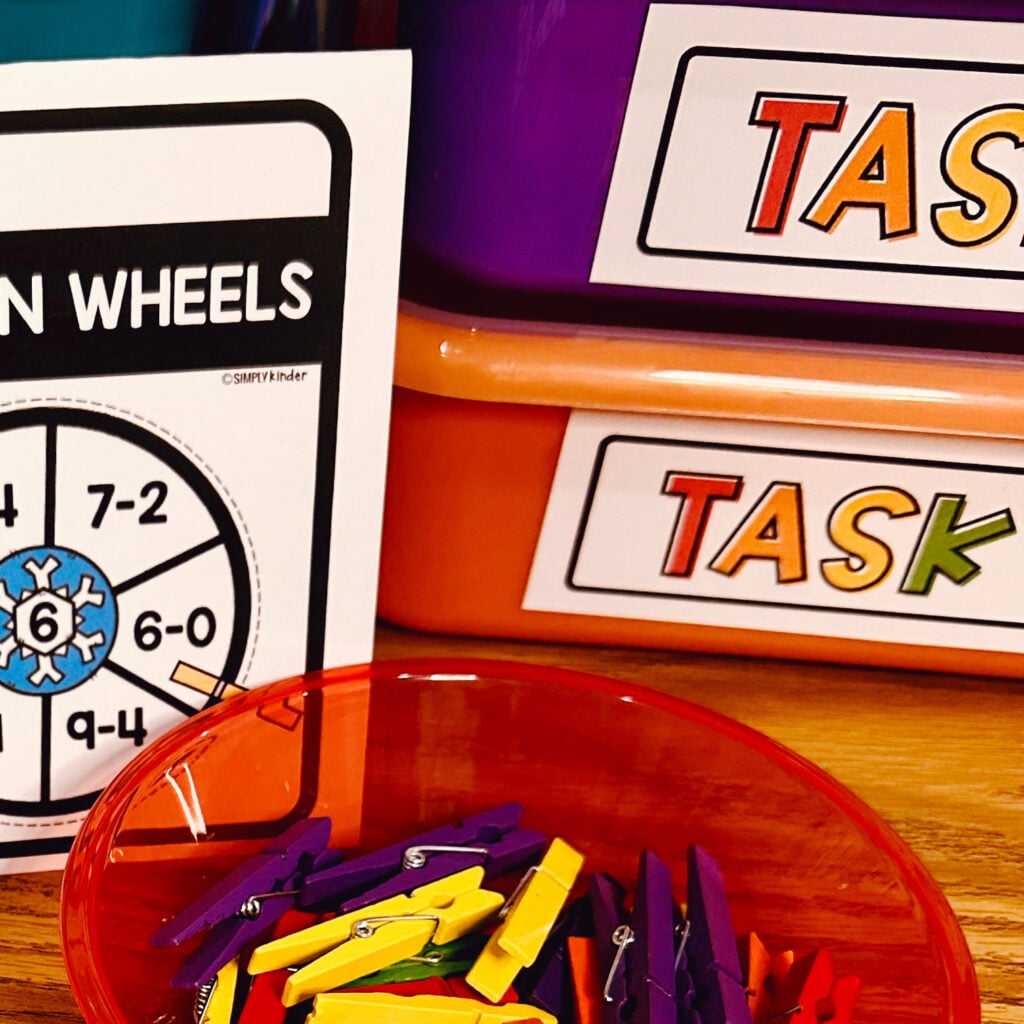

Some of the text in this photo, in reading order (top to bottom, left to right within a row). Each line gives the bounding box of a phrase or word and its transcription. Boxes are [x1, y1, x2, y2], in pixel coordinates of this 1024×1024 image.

[746, 92, 1024, 249] TAS
[69, 262, 313, 331] WHEELS
[88, 481, 167, 528] 7-2
[659, 470, 1018, 597] TASK
[30, 603, 58, 642] 6
[134, 607, 216, 651] 6-0
[67, 708, 147, 749] 9-4
